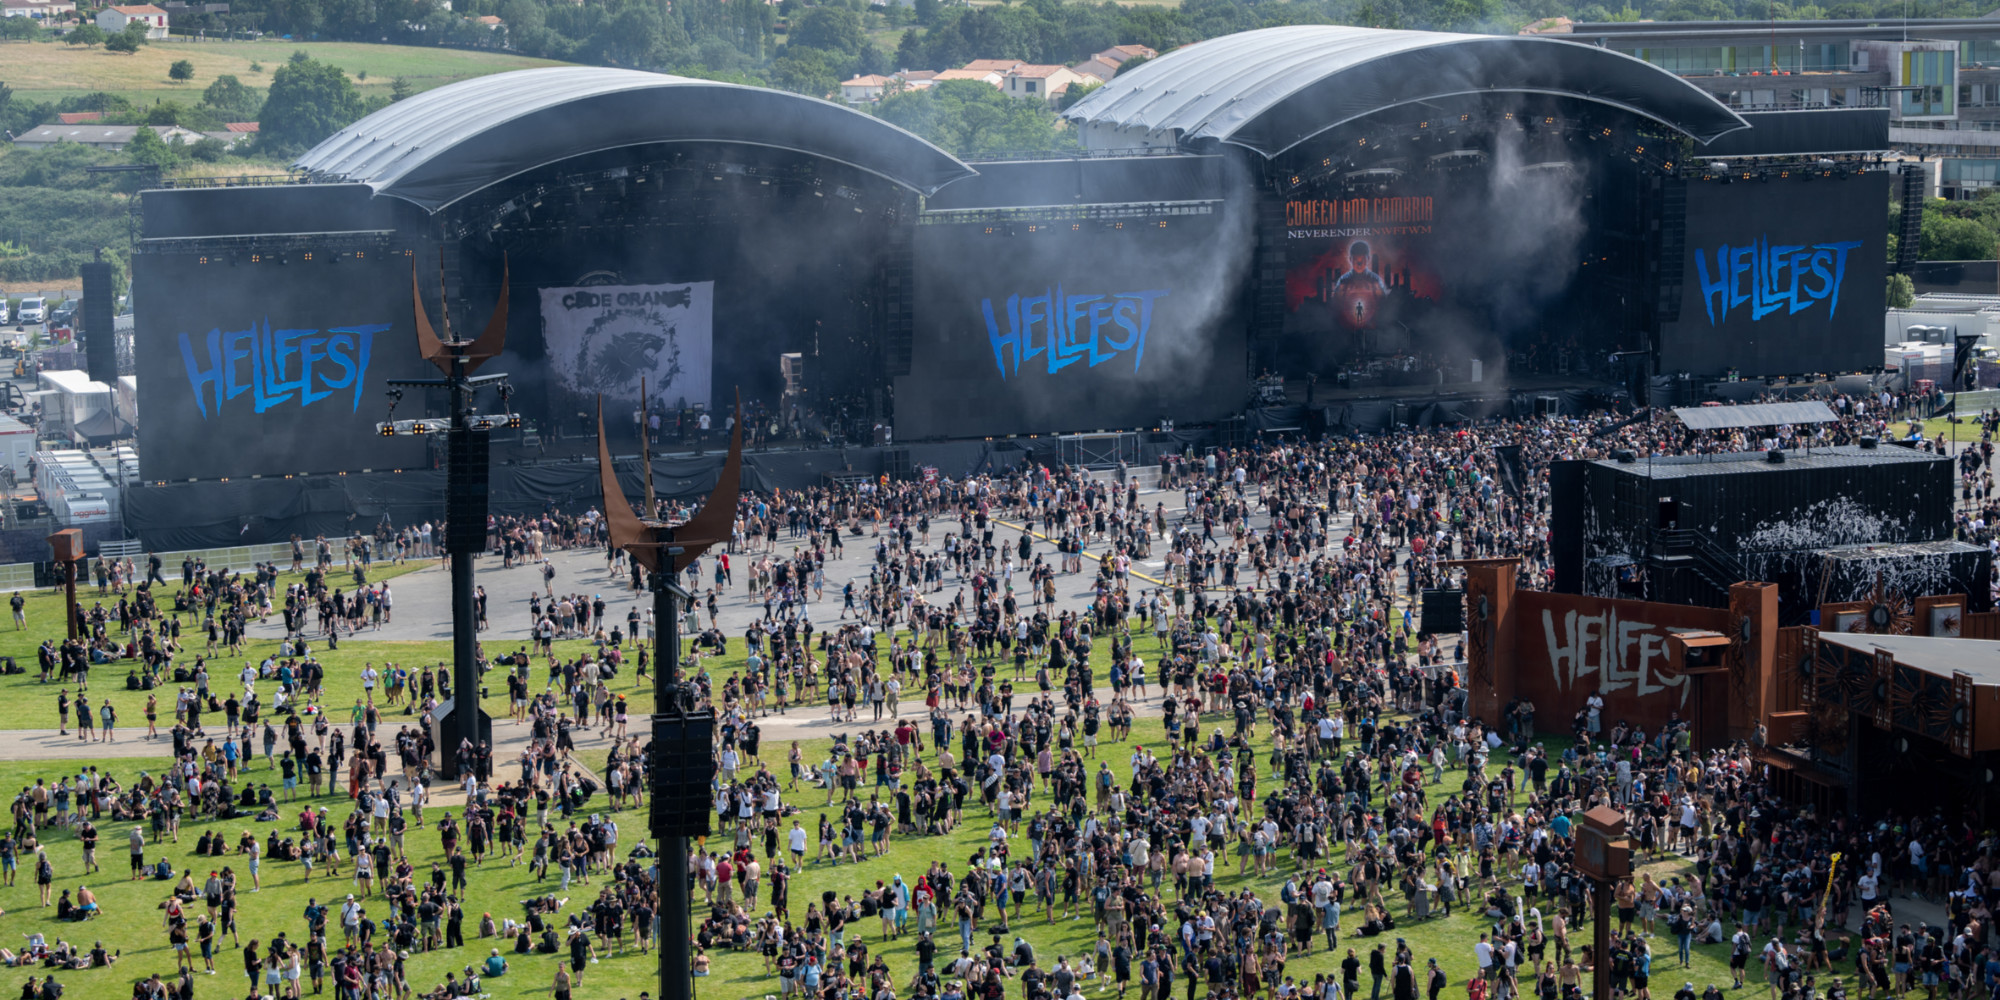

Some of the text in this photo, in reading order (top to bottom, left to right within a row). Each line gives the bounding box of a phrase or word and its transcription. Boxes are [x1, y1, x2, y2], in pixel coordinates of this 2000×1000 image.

[1343, 198, 1369, 224] AND
[1373, 196, 1433, 223] CAMBRIA
[562, 286, 692, 311] CDE ORANE
[1695, 232, 1864, 328] HELLFEST
[178, 315, 392, 421] HELLFEST
[982, 281, 1171, 382] HELLFEST
